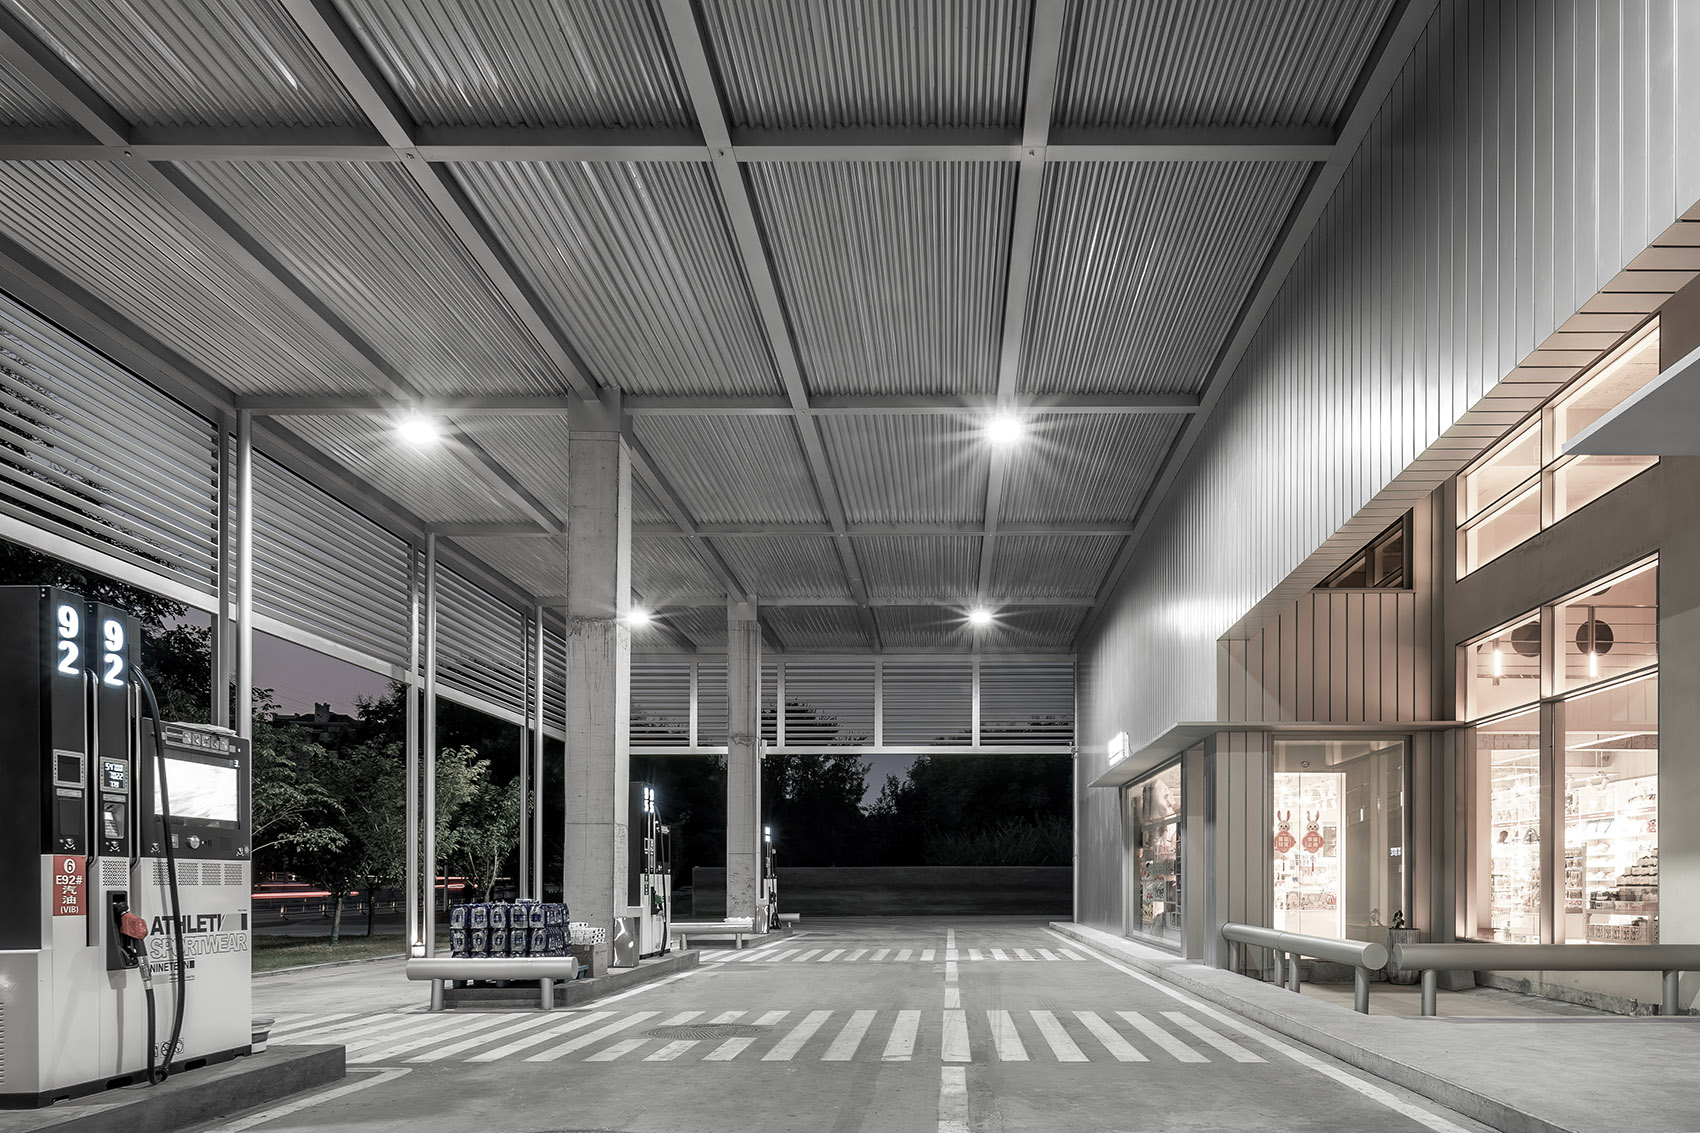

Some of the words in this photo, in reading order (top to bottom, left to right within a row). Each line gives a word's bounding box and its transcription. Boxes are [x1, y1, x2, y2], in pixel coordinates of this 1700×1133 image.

[57, 605, 79, 675] 92
[103, 620, 124, 686] 92
[64, 859, 76, 873] 6
[55, 875, 83, 885] E92#
[62, 885, 78, 904] 汽油
[150, 961, 189, 973] NINETEN
